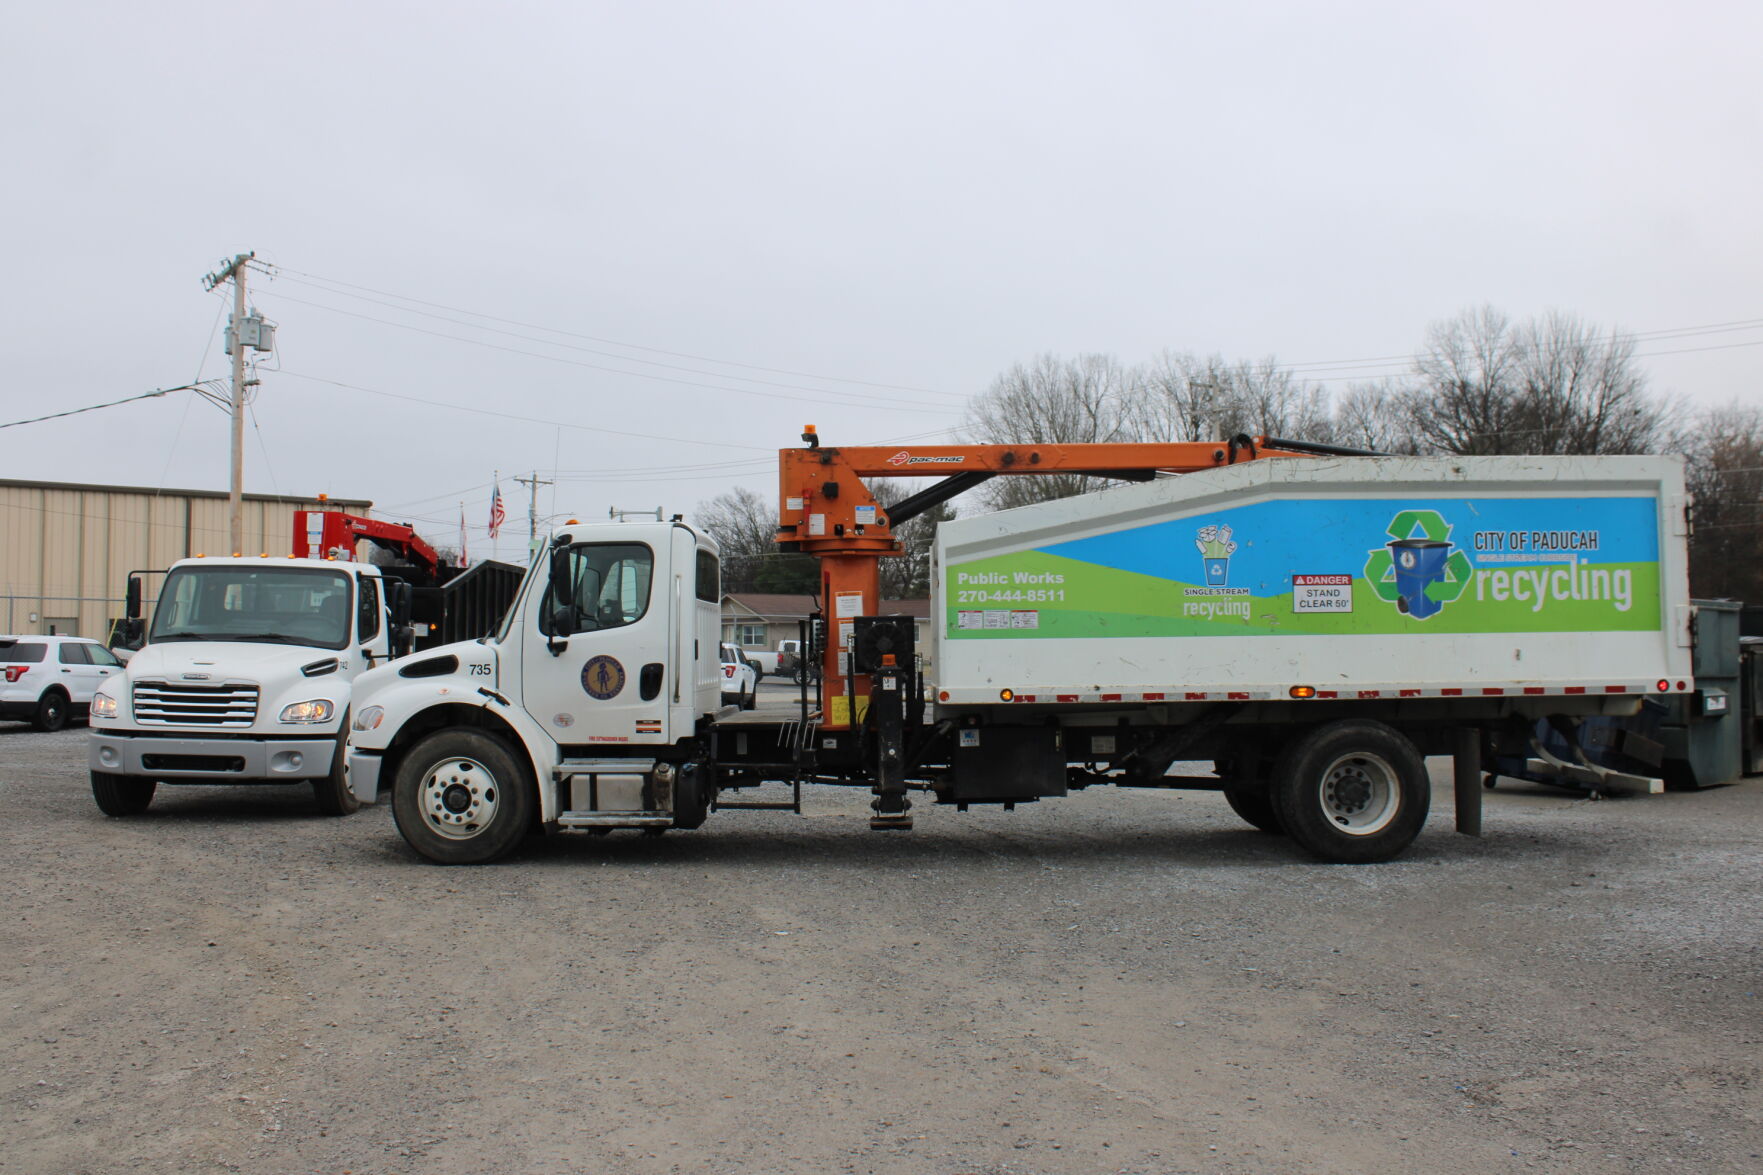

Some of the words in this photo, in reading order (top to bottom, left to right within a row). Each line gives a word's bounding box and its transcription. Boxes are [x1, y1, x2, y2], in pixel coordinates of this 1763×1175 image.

[907, 455, 965, 465] pac-mac
[1474, 531, 1505, 550] CITY
[1509, 531, 1528, 550] OF
[1532, 531, 1598, 550] PADUCAH
[958, 572, 1009, 585] Public
[1013, 571, 1065, 584] Works
[1306, 576, 1349, 585] DANGER
[1476, 555, 1632, 612] recycling
[958, 589, 1065, 603] 270-444-8511
[1184, 588, 1214, 596] SINGLE
[1306, 588, 1341, 598] STAND
[1183, 597, 1250, 621] recycling
[1299, 599, 1333, 608] CLEAR
[1335, 599, 1349, 608] 50'
[469, 663, 492, 676] 735
